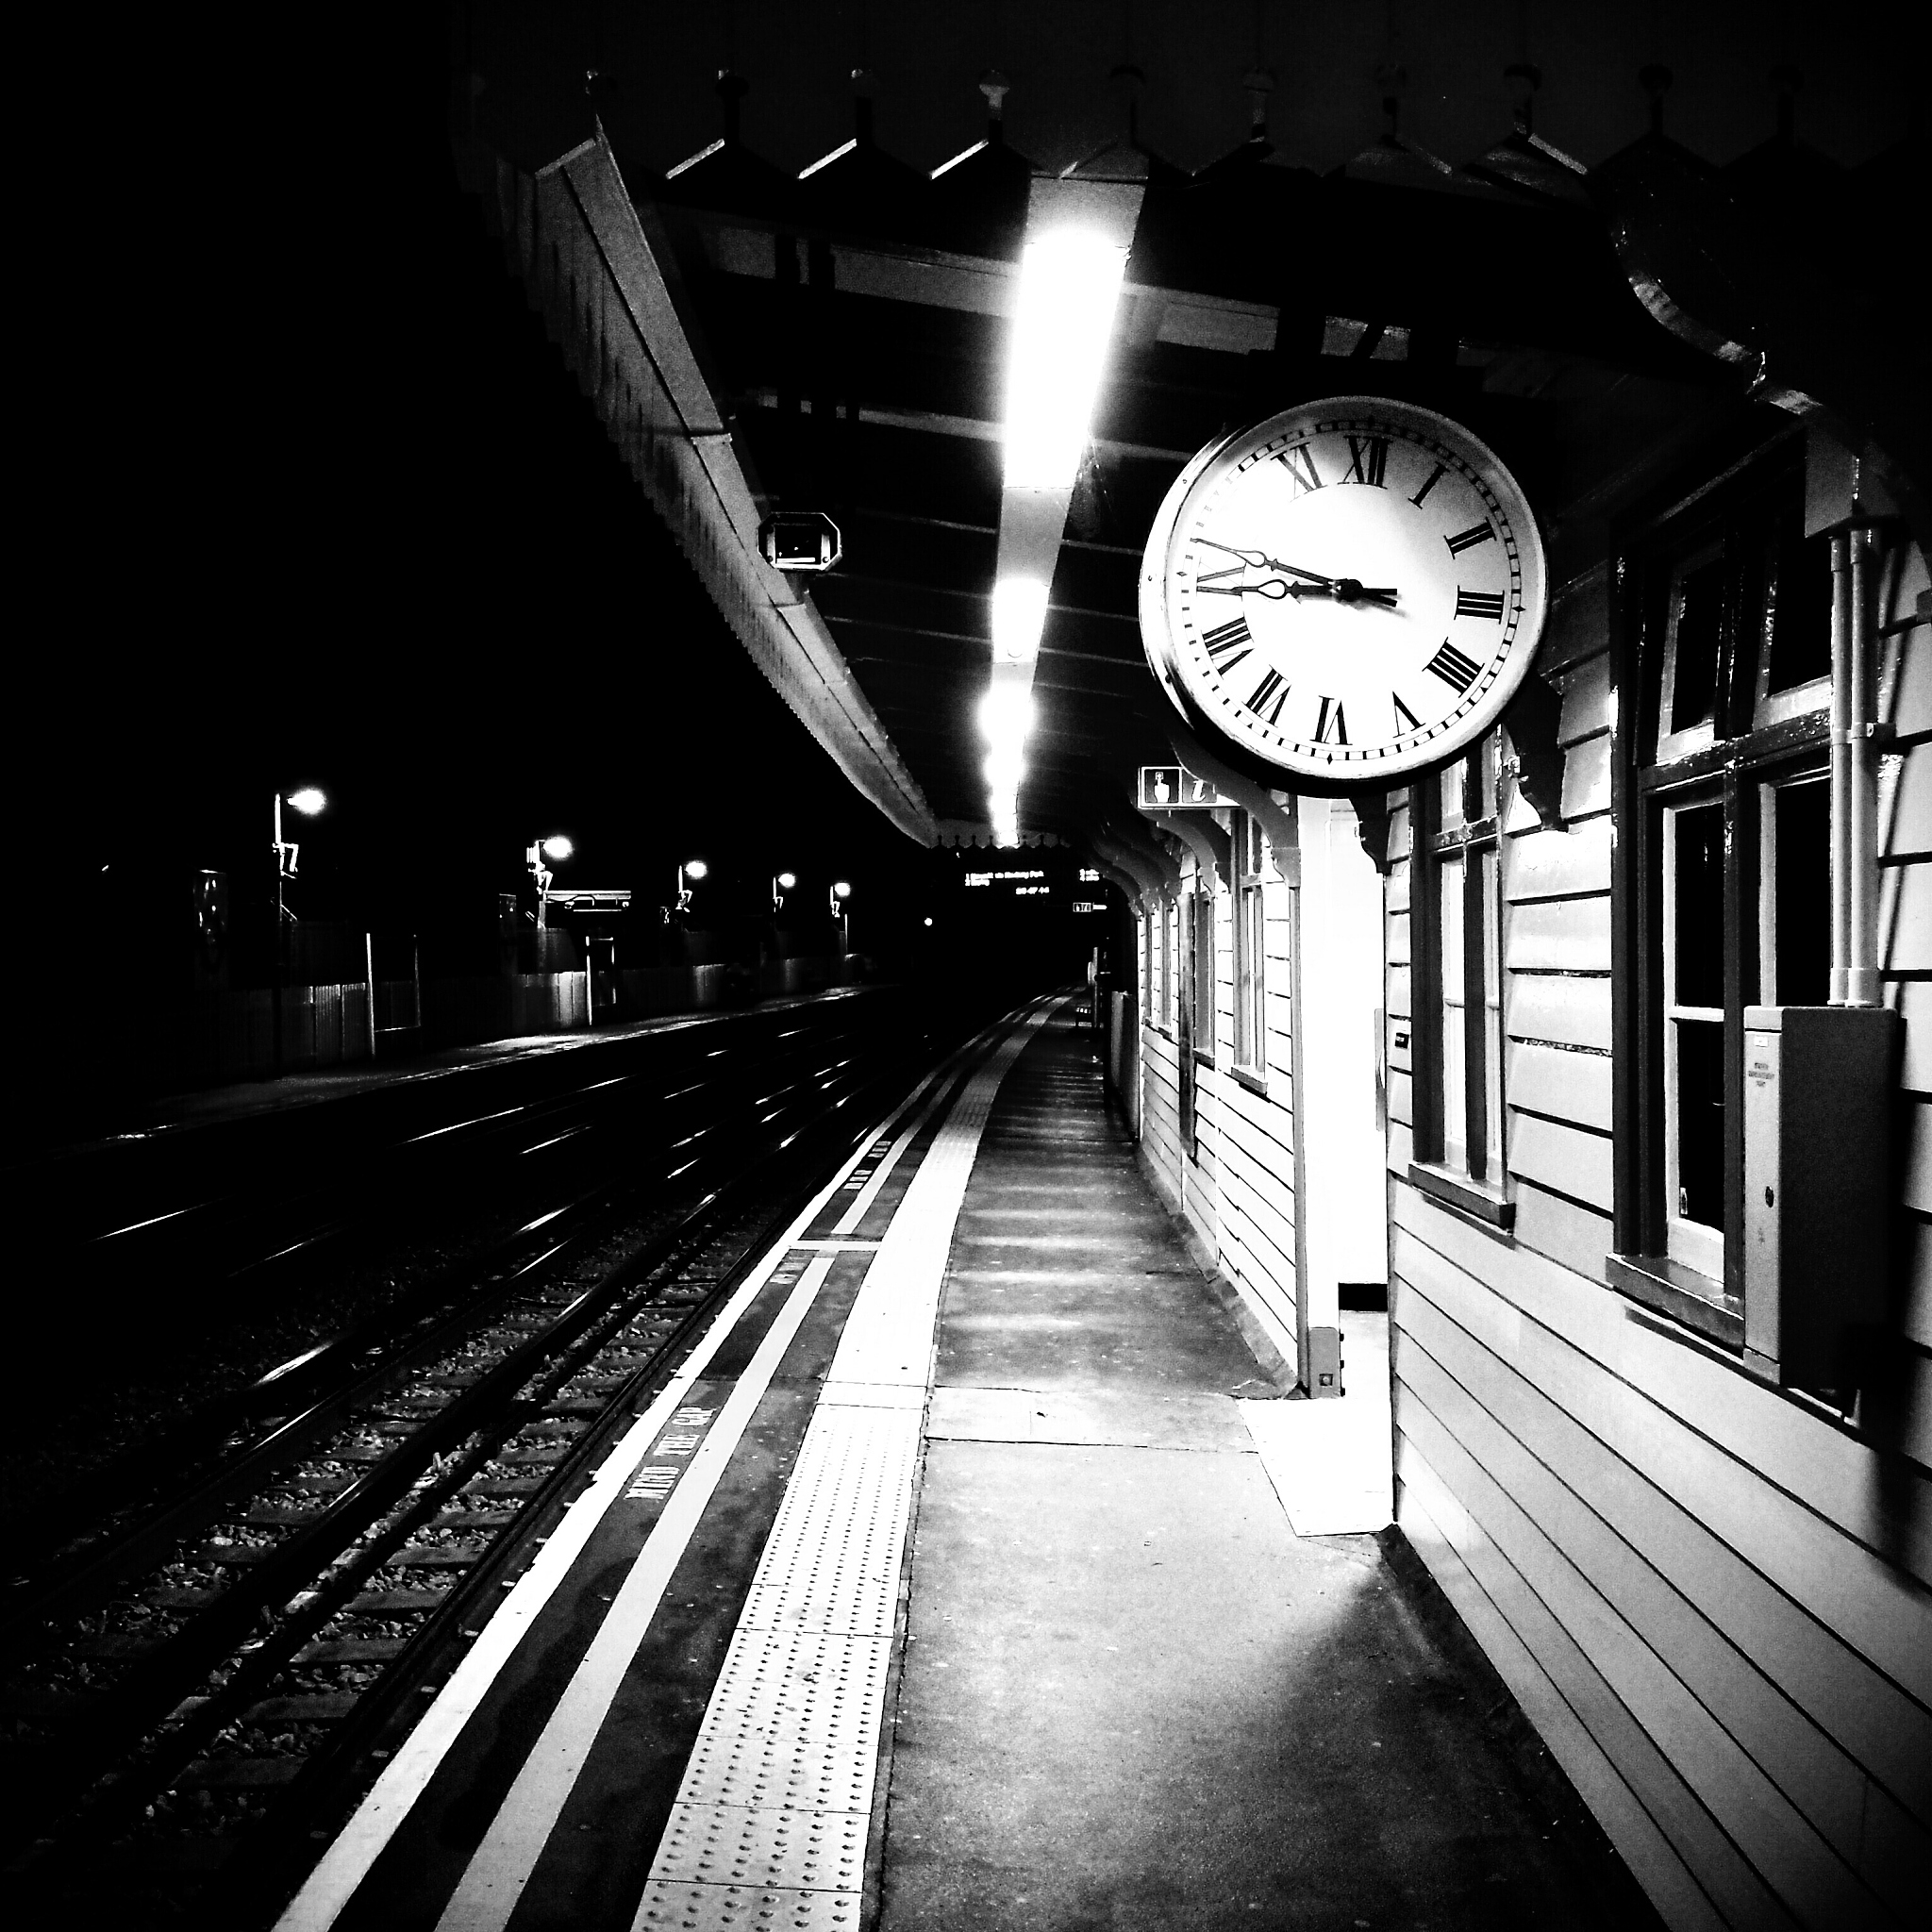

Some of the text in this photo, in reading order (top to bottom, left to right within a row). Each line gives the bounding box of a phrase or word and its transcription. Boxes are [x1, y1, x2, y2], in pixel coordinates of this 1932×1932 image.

[1271, 442, 1328, 503] XI
[1337, 435, 1393, 490] XII
[1407, 460, 1451, 509] I
[1443, 517, 1497, 559] II
[1454, 585, 1505, 625] III
[1200, 611, 1256, 680] VIII
[1422, 637, 1485, 698] IIII
[1241, 664, 1291, 728] VII
[1309, 695, 1353, 745] VI
[1392, 691, 1425, 738] V
[672, 1406, 717, 1426] GAP
[653, 1434, 700, 1456] THE
